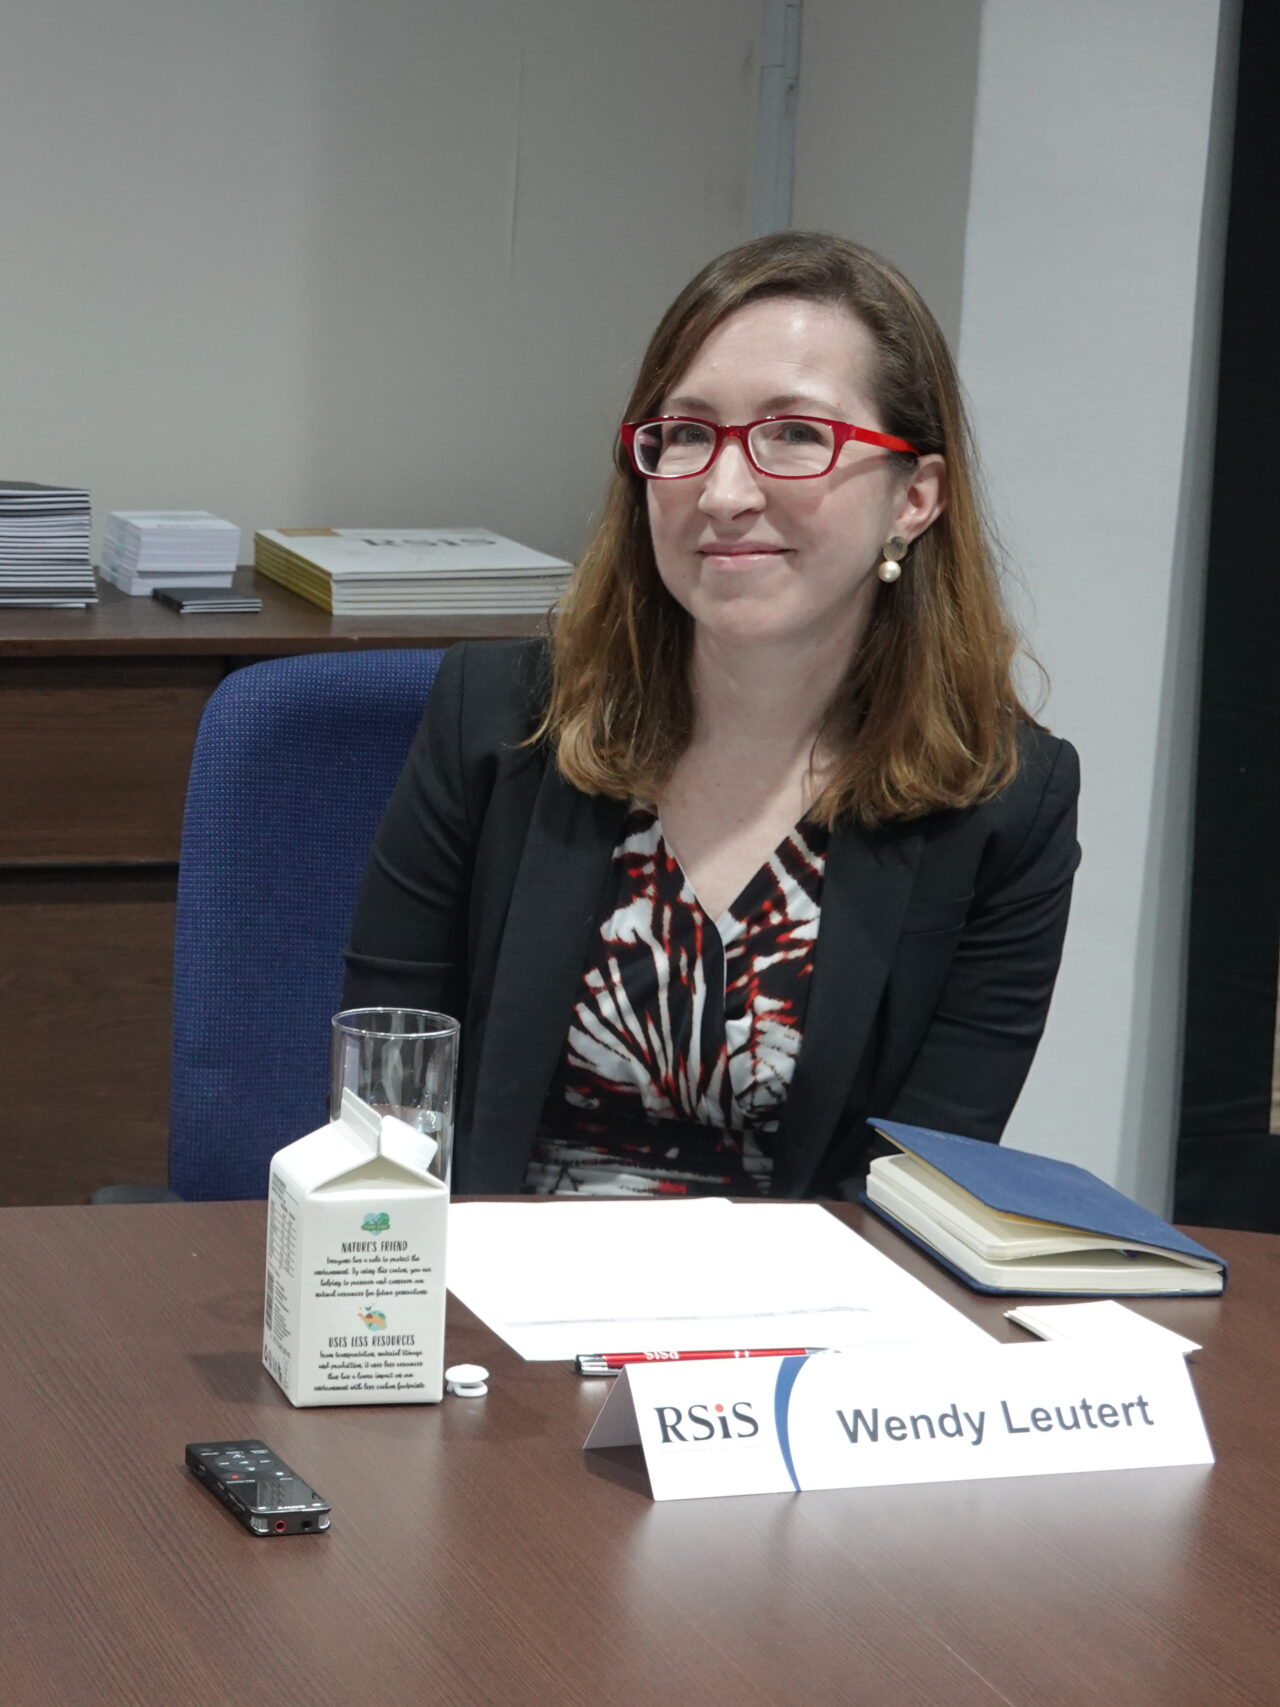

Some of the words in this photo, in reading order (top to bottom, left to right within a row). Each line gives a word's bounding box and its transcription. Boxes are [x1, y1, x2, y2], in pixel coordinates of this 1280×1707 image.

[342, 1241, 377, 1253] NATURE'S
[381, 1240, 408, 1251] FRIEND
[329, 1337, 347, 1347] USES
[351, 1336, 368, 1347] LESS
[372, 1335, 415, 1346] RESOURCES
[835, 1403, 986, 1447] Wendy
[1000, 1394, 1155, 1434] Leutert
